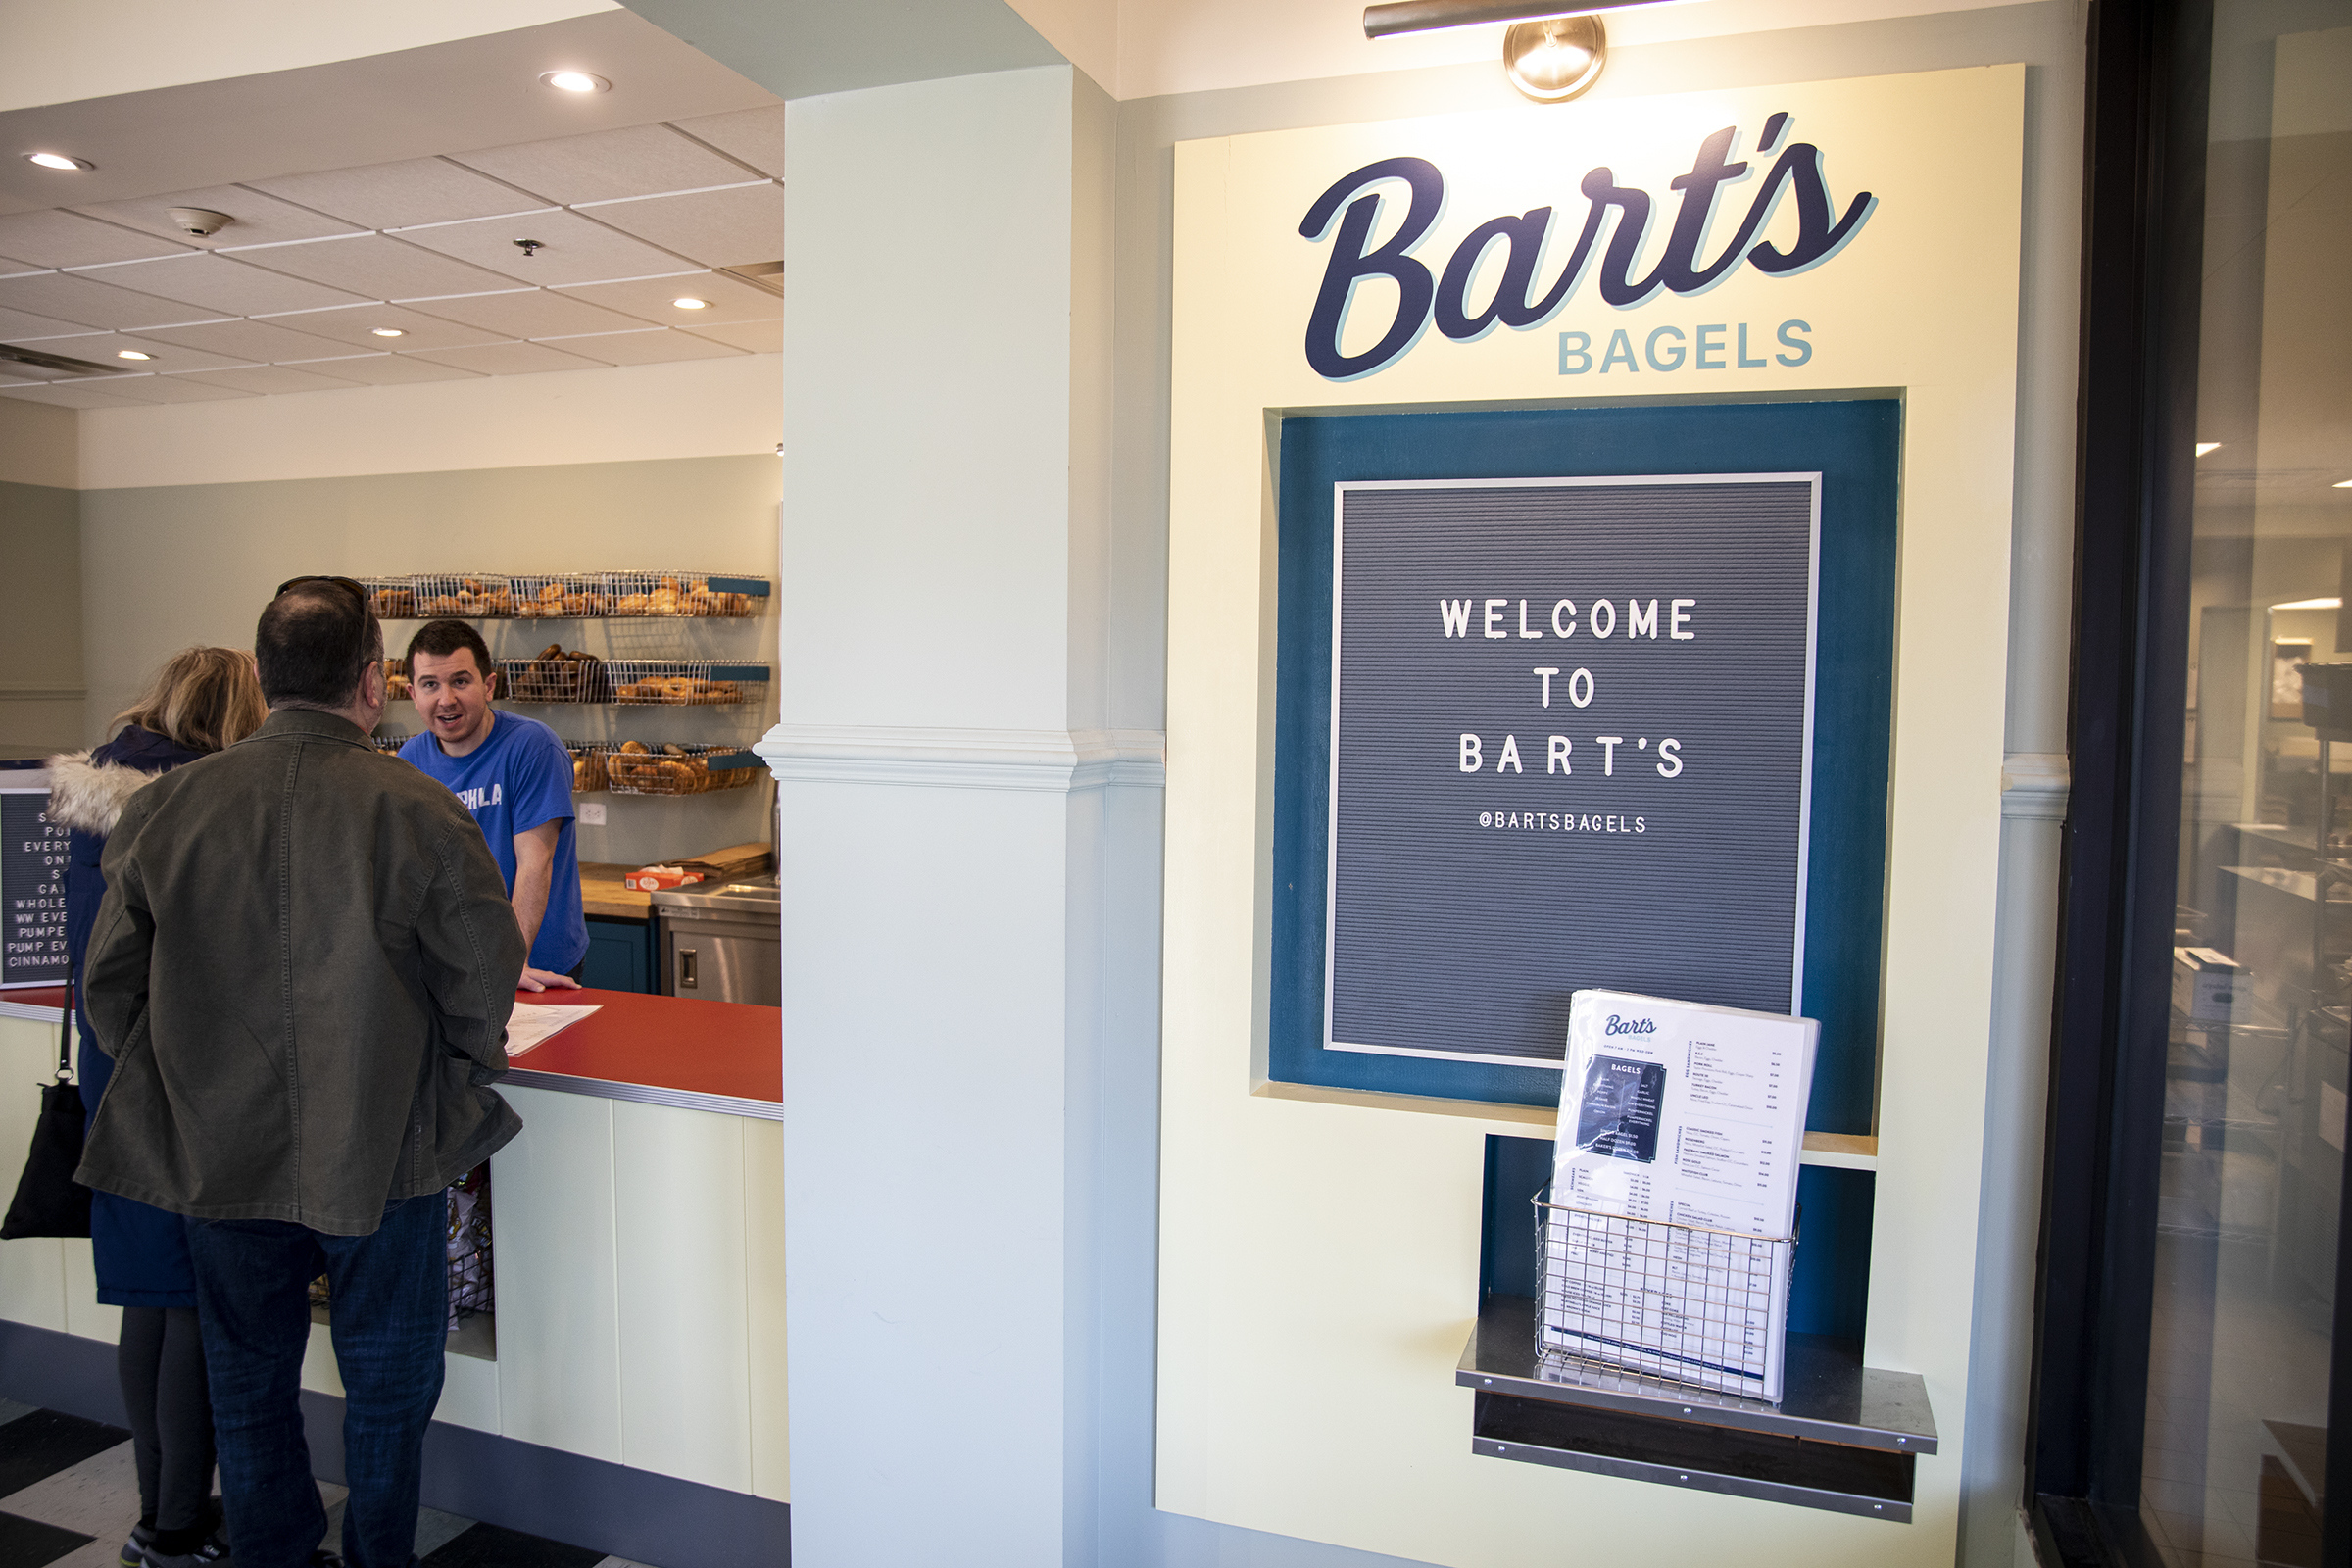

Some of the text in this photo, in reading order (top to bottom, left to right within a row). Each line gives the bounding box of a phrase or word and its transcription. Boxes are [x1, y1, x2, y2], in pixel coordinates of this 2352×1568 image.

[1298, 112, 1879, 382] Bart's
[1558, 318, 1813, 376] BAGELS
[1440, 599, 1695, 640] WELCOME
[1533, 667, 1594, 708] TO
[1460, 734, 1683, 778] BART'S
[1479, 812, 1646, 833] @BARTSBAGELS
[38, 884, 66, 894] GA
[16, 898, 67, 909] WHOLE
[16, 913, 34, 924] WW
[19, 926, 66, 938] PUMPE
[8, 942, 44, 953] PUMP
[9, 955, 70, 967] CINNAMO
[1605, 1014, 1657, 1036] Bart's
[1628, 1034, 1651, 1043] BAGELS
[1611, 1063, 1641, 1074] BAGELS
